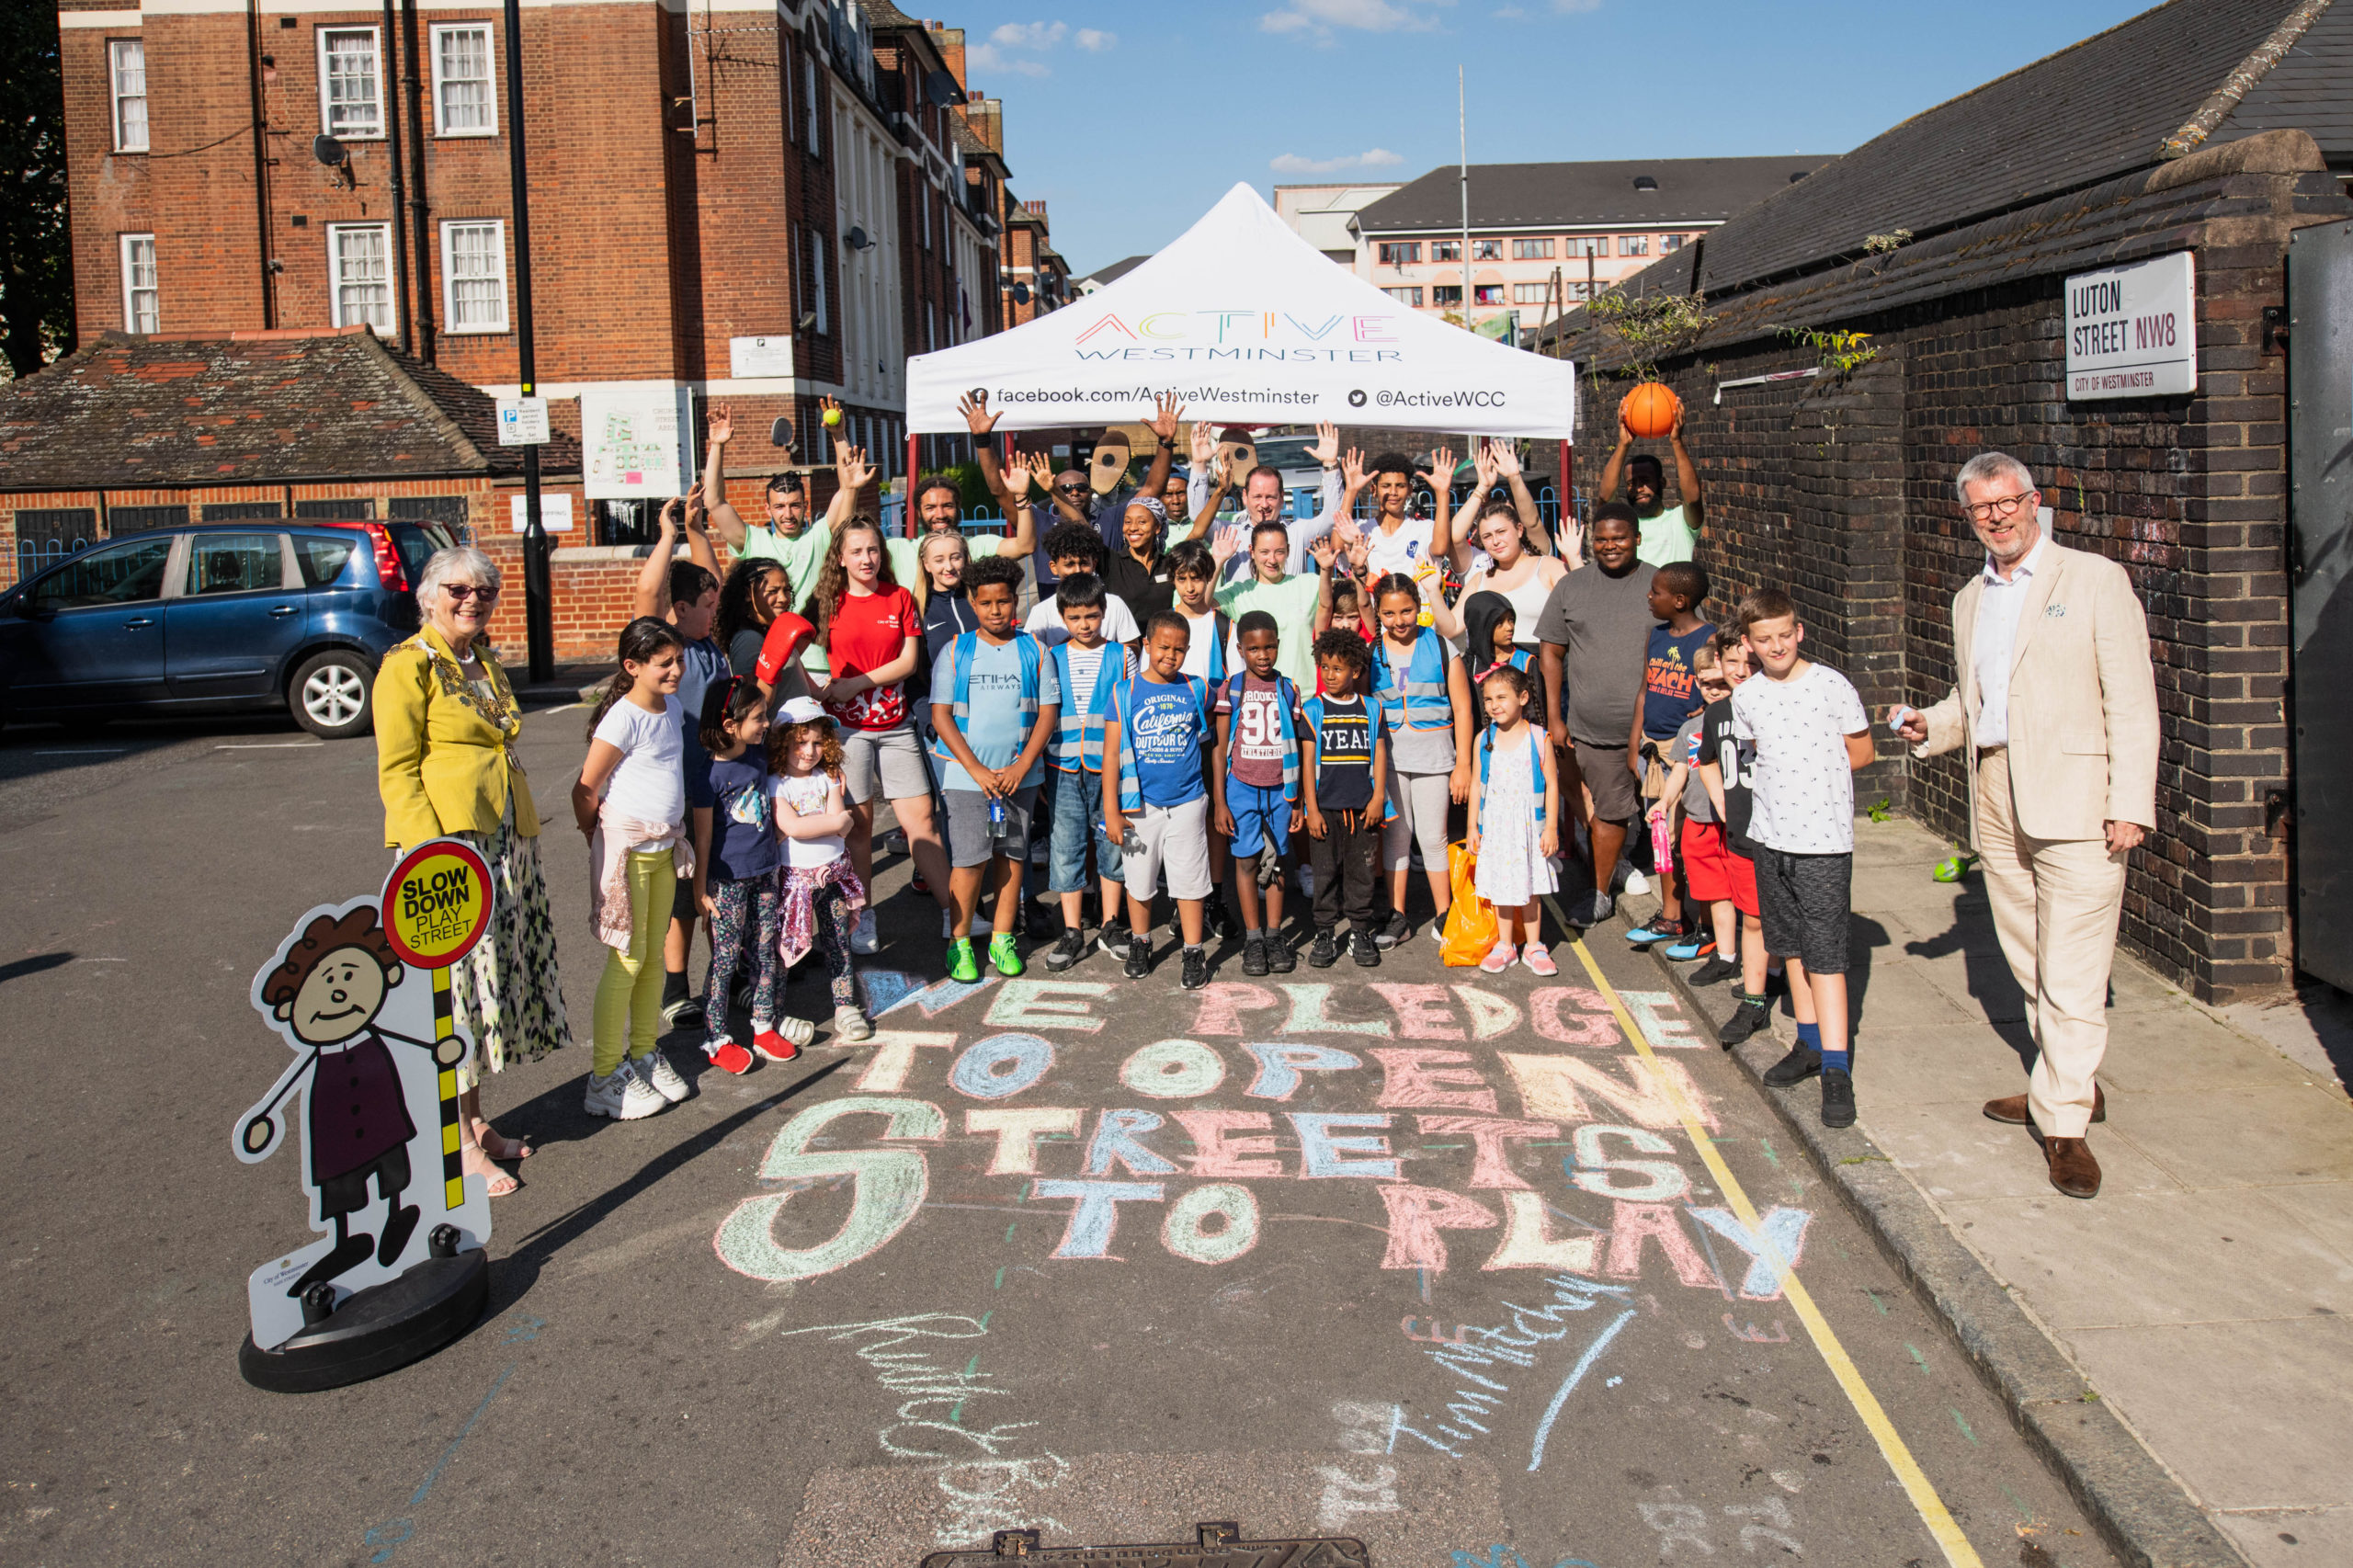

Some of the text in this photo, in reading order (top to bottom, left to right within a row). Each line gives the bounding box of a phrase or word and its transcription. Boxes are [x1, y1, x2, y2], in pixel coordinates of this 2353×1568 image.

[2073, 279, 2121, 319] LUTON
[1075, 310, 1399, 345] ACTIVE
[2074, 312, 2177, 357] STREET NW8
[1074, 347, 1403, 362] WESTMINSTER
[2075, 371, 2154, 392] CITY OF WESTMINSTER
[1376, 390, 1506, 407] @ActiveWCC
[969, 674, 1021, 684] ETIHA
[980, 683, 1021, 691] AIRWAYS
[1144, 694, 1188, 706] ORIGINAL
[1132, 705, 1193, 735] California
[1135, 733, 1176, 749] OUTDOOR
[1321, 730, 1371, 750] YEAH
[402, 865, 469, 900] SLOW
[404, 884, 470, 919] DOWN
[415, 904, 462, 933] PLAY
[410, 919, 472, 949] STREET
[1185, 981, 1711, 1050] PLEDGE
[832, 1028, 1721, 1134] TO OPEN
[711, 1096, 1693, 1282] STREETS
[1028, 1178, 1813, 1301] TO PLAY
